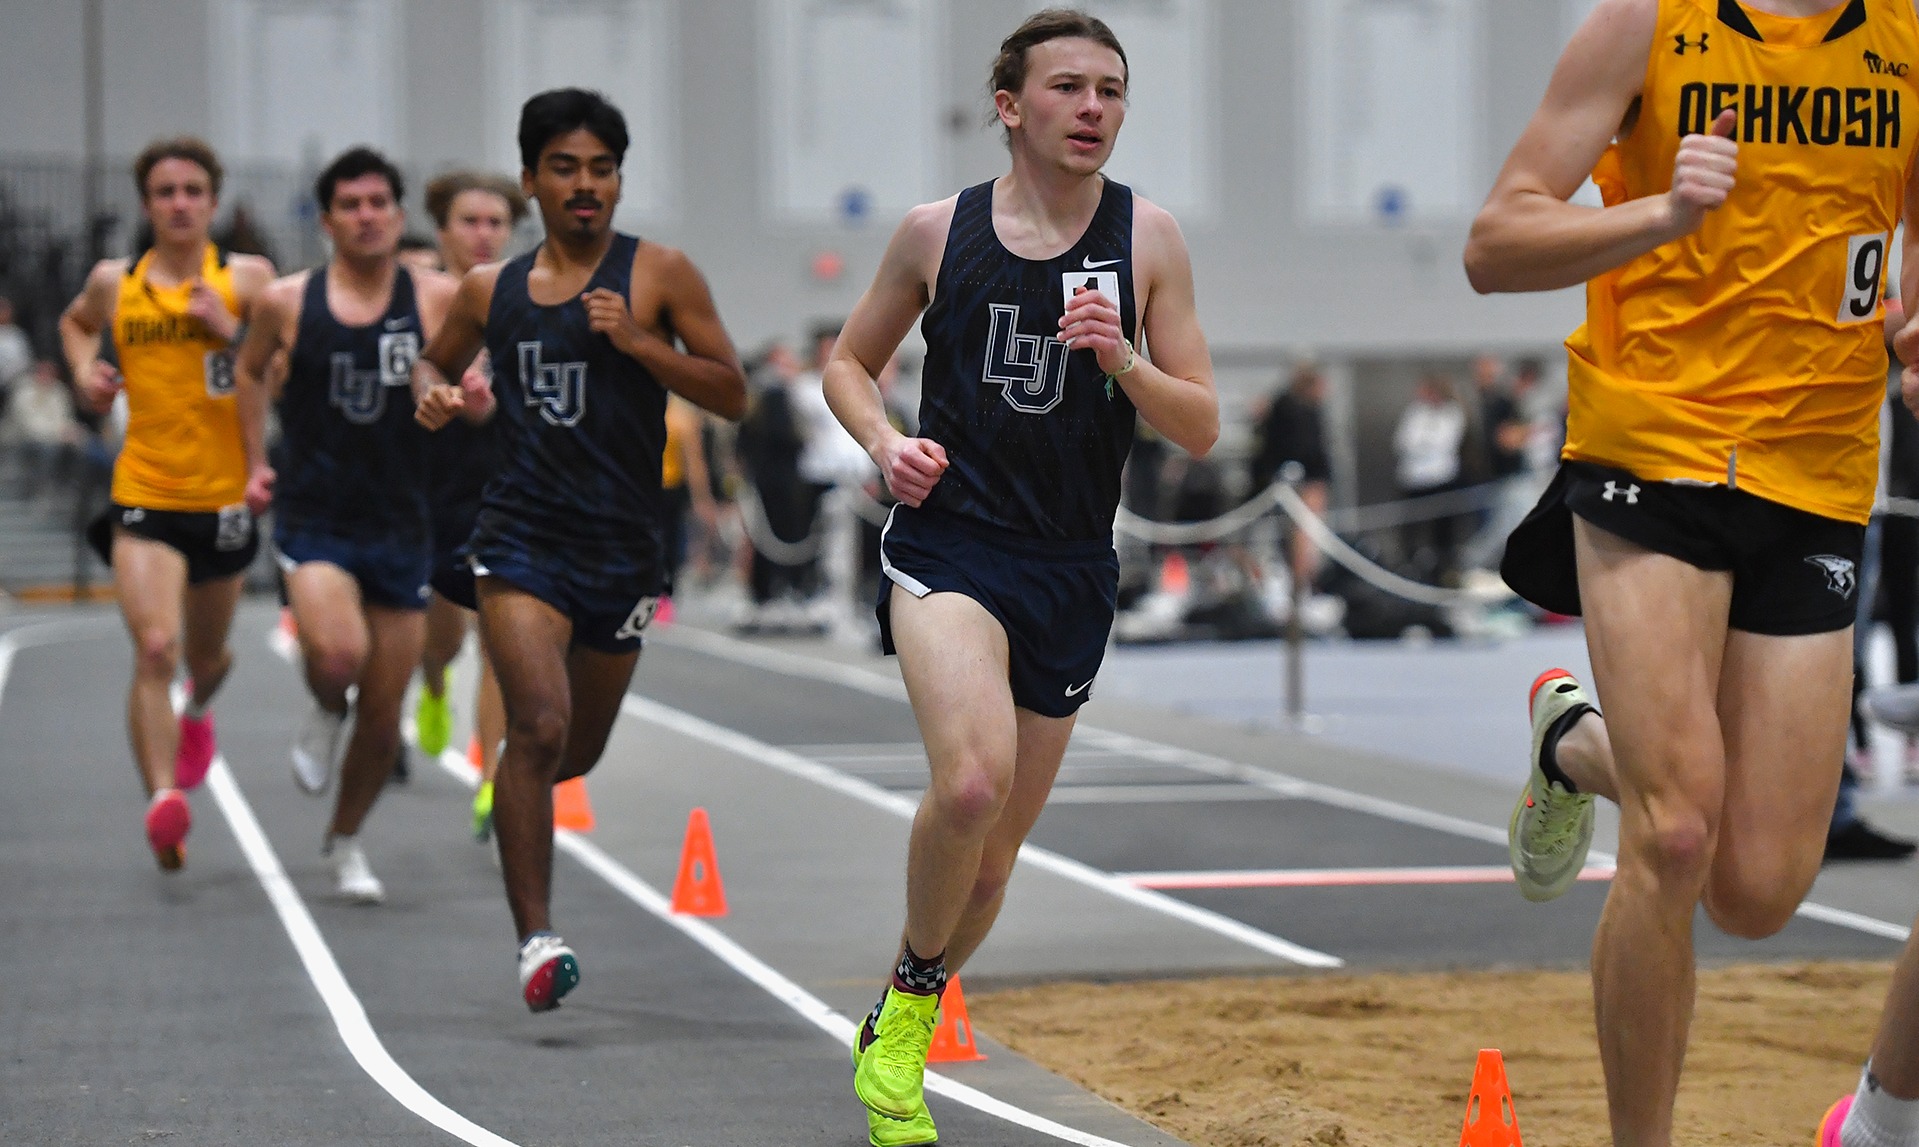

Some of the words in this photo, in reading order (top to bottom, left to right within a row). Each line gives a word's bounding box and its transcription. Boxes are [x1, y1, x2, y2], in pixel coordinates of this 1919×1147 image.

[1678, 82, 1900, 148] OSHKOSH
[1850, 240, 1883, 317] 9
[389, 341, 411, 376] 6
[517, 341, 587, 427] LU
[982, 303, 1070, 414] LU
